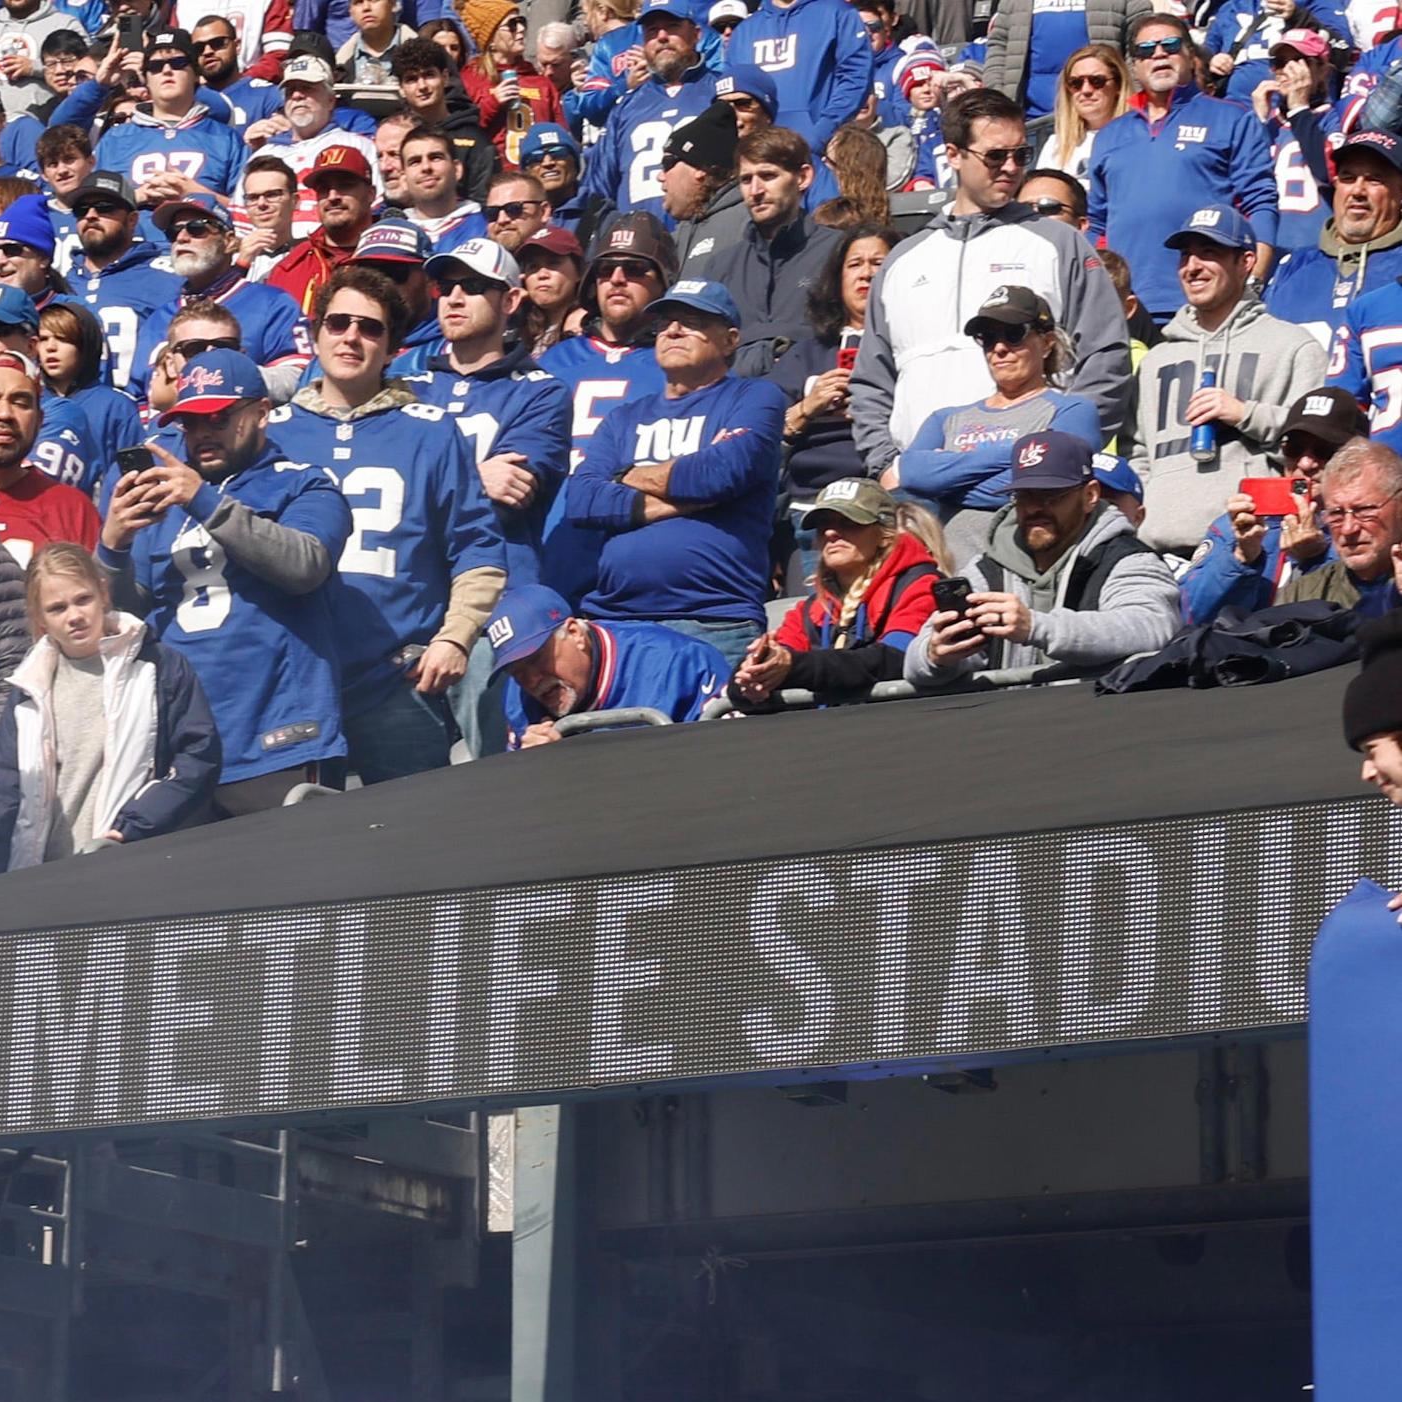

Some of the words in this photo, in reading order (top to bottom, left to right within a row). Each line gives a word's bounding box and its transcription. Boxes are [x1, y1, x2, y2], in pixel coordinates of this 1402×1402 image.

[752, 34, 797, 73] ny
[954, 427, 1020, 446] GIANTS
[36, 442, 85, 486] 98
[7, 880, 676, 1126] METLIFE
[742, 807, 1402, 1063] STADIU
